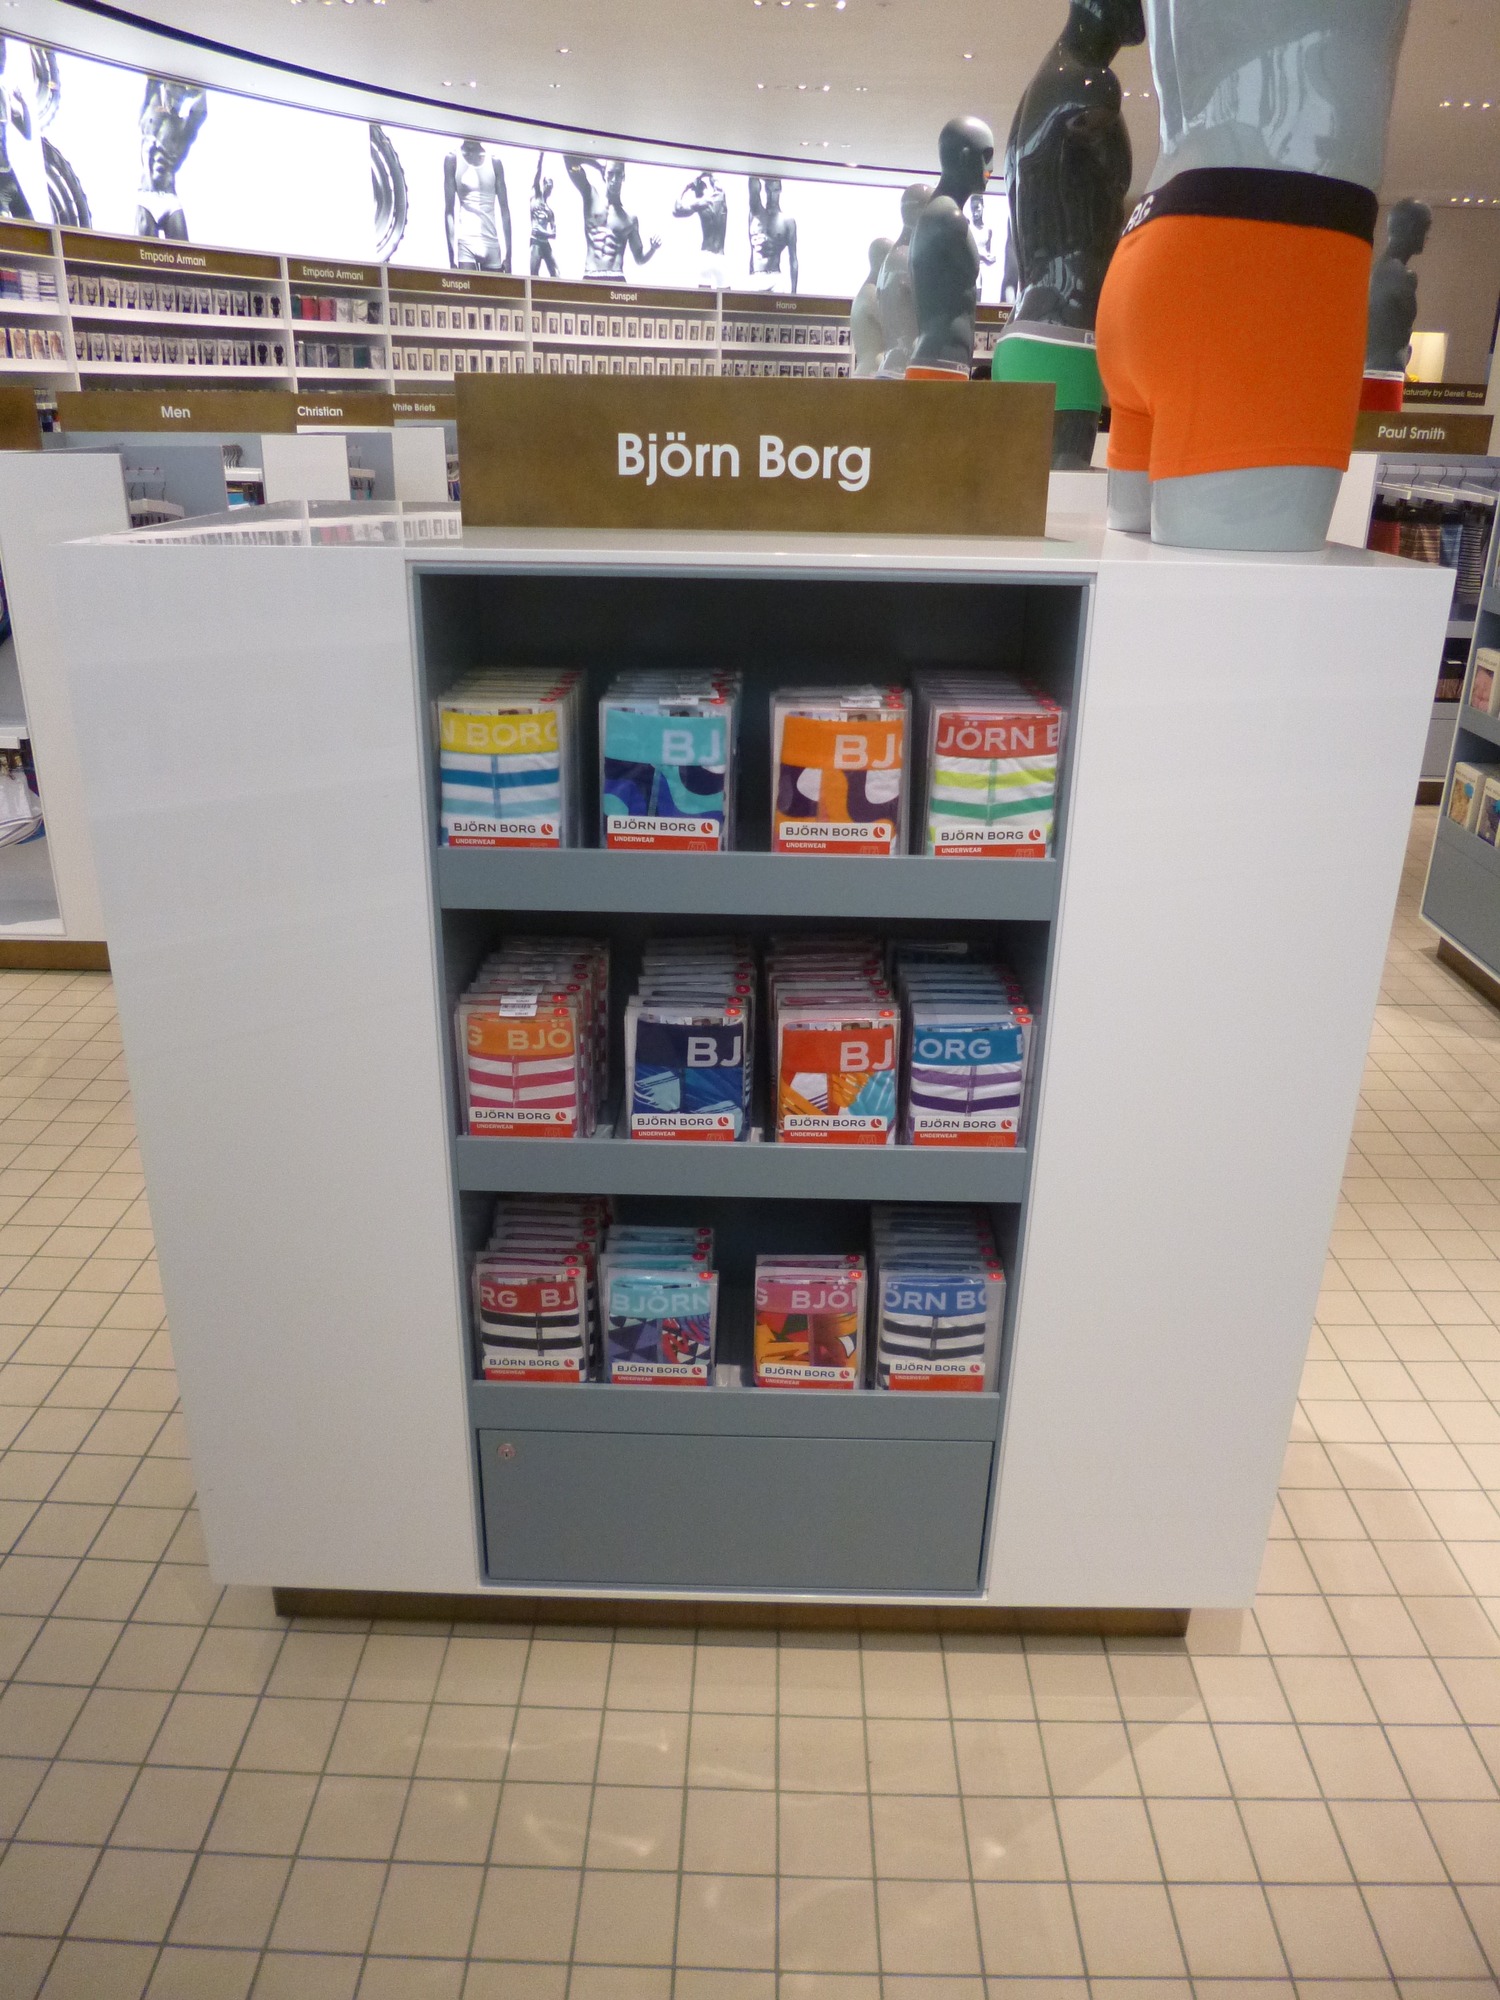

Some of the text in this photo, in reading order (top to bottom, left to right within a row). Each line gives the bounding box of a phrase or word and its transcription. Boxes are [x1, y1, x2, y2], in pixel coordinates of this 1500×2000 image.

[140, 249, 206, 267] Emporio Armani
[303, 266, 364, 281] Emporio Armani
[441, 278, 470, 291] Sunspel
[610, 290, 638, 302] Sunspel
[776, 301, 797, 311] Hanro
[1433, 388, 1443, 398] by
[161, 405, 191, 419] Men
[297, 405, 343, 418] Christian
[414, 403, 436, 412] Briefs
[1377, 425, 1446, 441] Paul Smith
[617, 431, 871, 492] Björn Borg
[662, 730, 719, 765] BJ
[454, 821, 536, 833] BJÖRN BORG
[614, 819, 696, 831] BJÖRN BORG
[786, 826, 868, 837] BJÖRN BORG
[941, 830, 1023, 841] BJÖRN BORG
[687, 1036, 741, 1067] BJ
[840, 1039, 893, 1072] BJ
[475, 1110, 514, 1119] BJÖRN
[637, 1116, 713, 1126] BJÖRN BORG
[790, 1118, 866, 1127] BJÖRN BORG
[921, 1119, 959, 1128] BJÖRN
[541, 1286, 576, 1307] BJ
[490, 1358, 525, 1366] BJÖRN
[896, 1363, 931, 1371] BJÖRN
[617, 1365, 653, 1373] BJÖRN
[765, 1367, 801, 1376] BJÖRN
